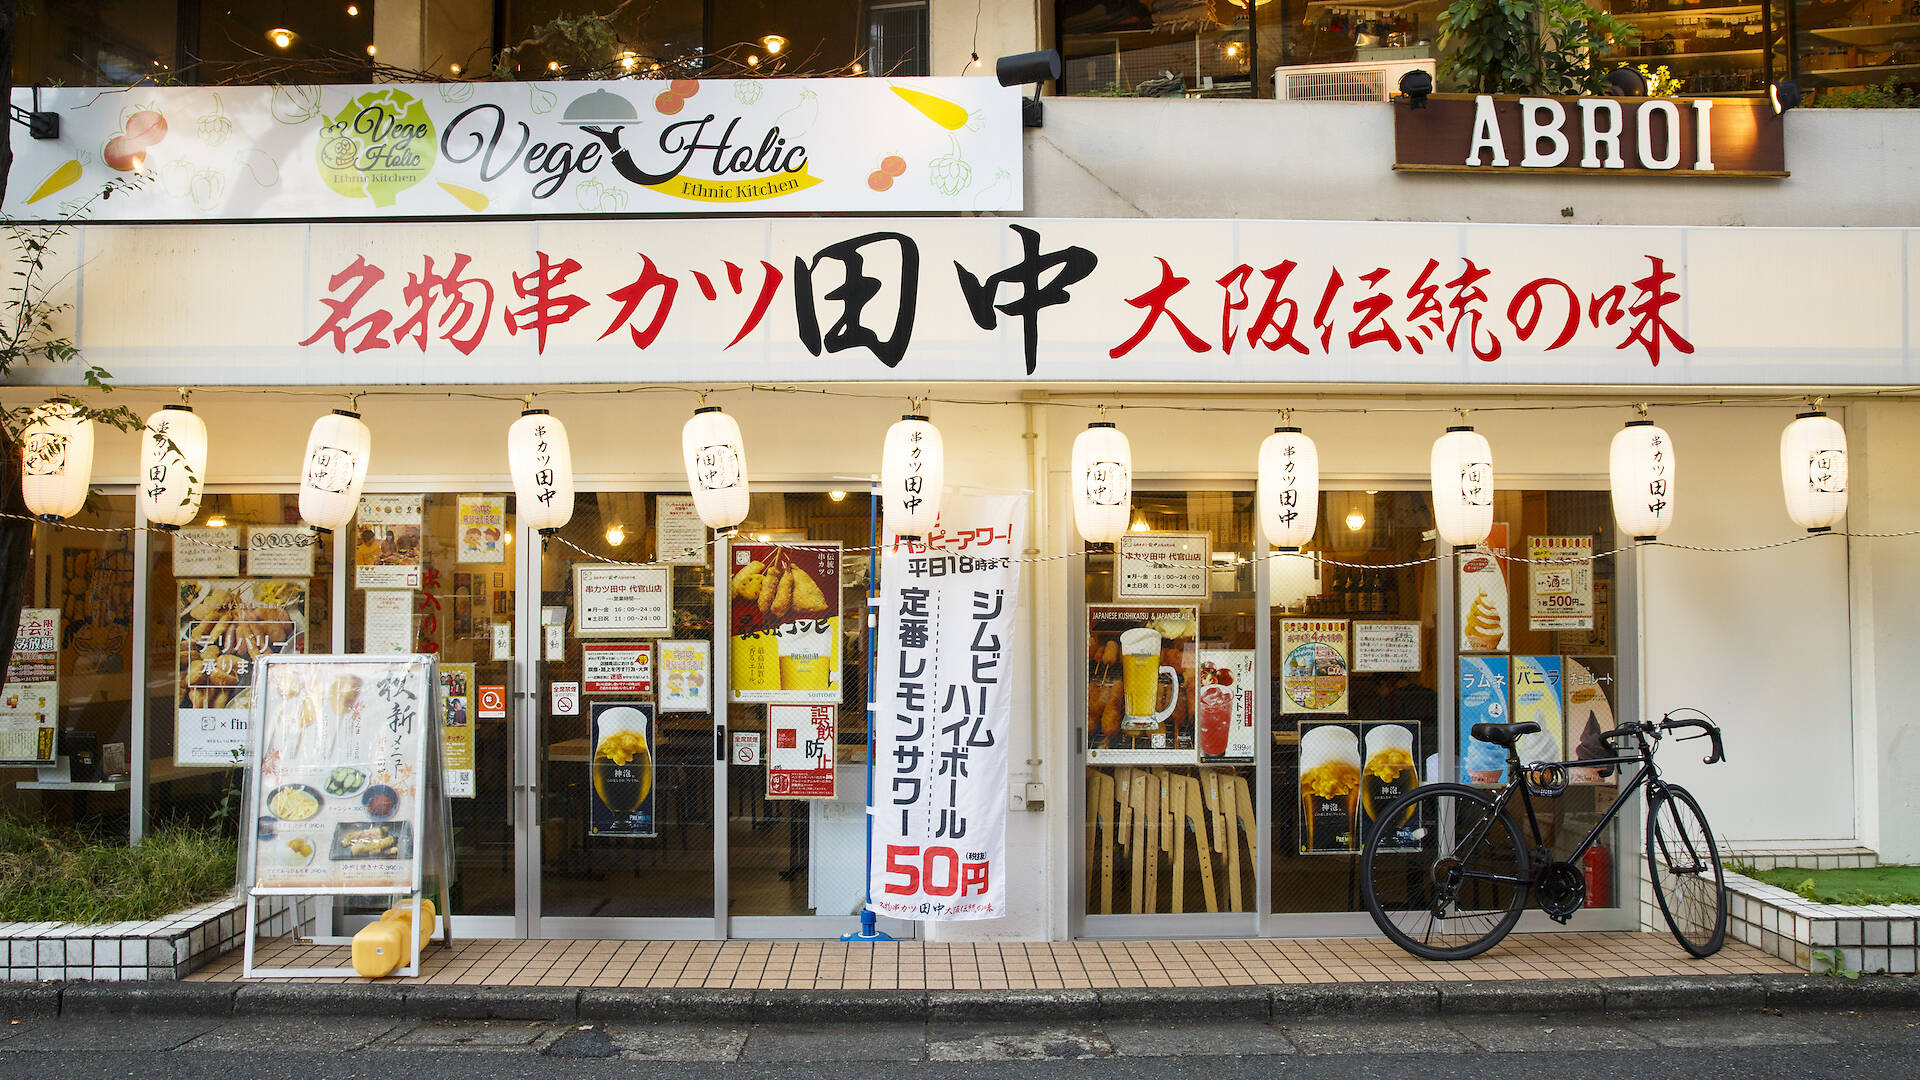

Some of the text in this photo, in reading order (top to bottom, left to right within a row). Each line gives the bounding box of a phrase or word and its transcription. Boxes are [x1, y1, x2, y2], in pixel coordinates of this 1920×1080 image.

[354, 106, 428, 149] Vege
[1466, 95, 1715, 171] ABROI
[354, 144, 421, 171] Holic
[441, 103, 808, 199] Vege Holic
[372, 174, 416, 182] Kitchen
[682, 178, 799, 199] Ethnic Kitchen
[1109, 255, 1695, 368] 大阪伝統の味
[534, 425, 557, 508] 串カツ田中
[903, 431, 924, 515] 串カツ田中
[1648, 436, 1667, 519] 串カツ田中
[1278, 445, 1299, 529] 串カツ田中
[826, 553, 835, 575] 伝統の
[908, 556, 1010, 578] 平日18時まで
[1125, 552, 1201, 561] 串カツ田中 代官山店
[585, 584, 662, 594] 串カツ田中 代官山店
[1092, 612, 1118, 620] JAPANESE
[14, 636, 54, 651] み放題
[196, 634, 289, 654] デリバリー
[201, 658, 255, 675] 承りま
[966, 589, 1004, 748] ジムビーム
[1517, 670, 1561, 687] バニラ
[1569, 672, 1614, 686] チョコレート
[1462, 673, 1507, 689] ラムネ
[892, 586, 930, 837] 定番レモンサワー
[805, 706, 835, 770] 誤飲防止
[935, 684, 971, 839] ハイボール
[884, 843, 990, 898] 50円
